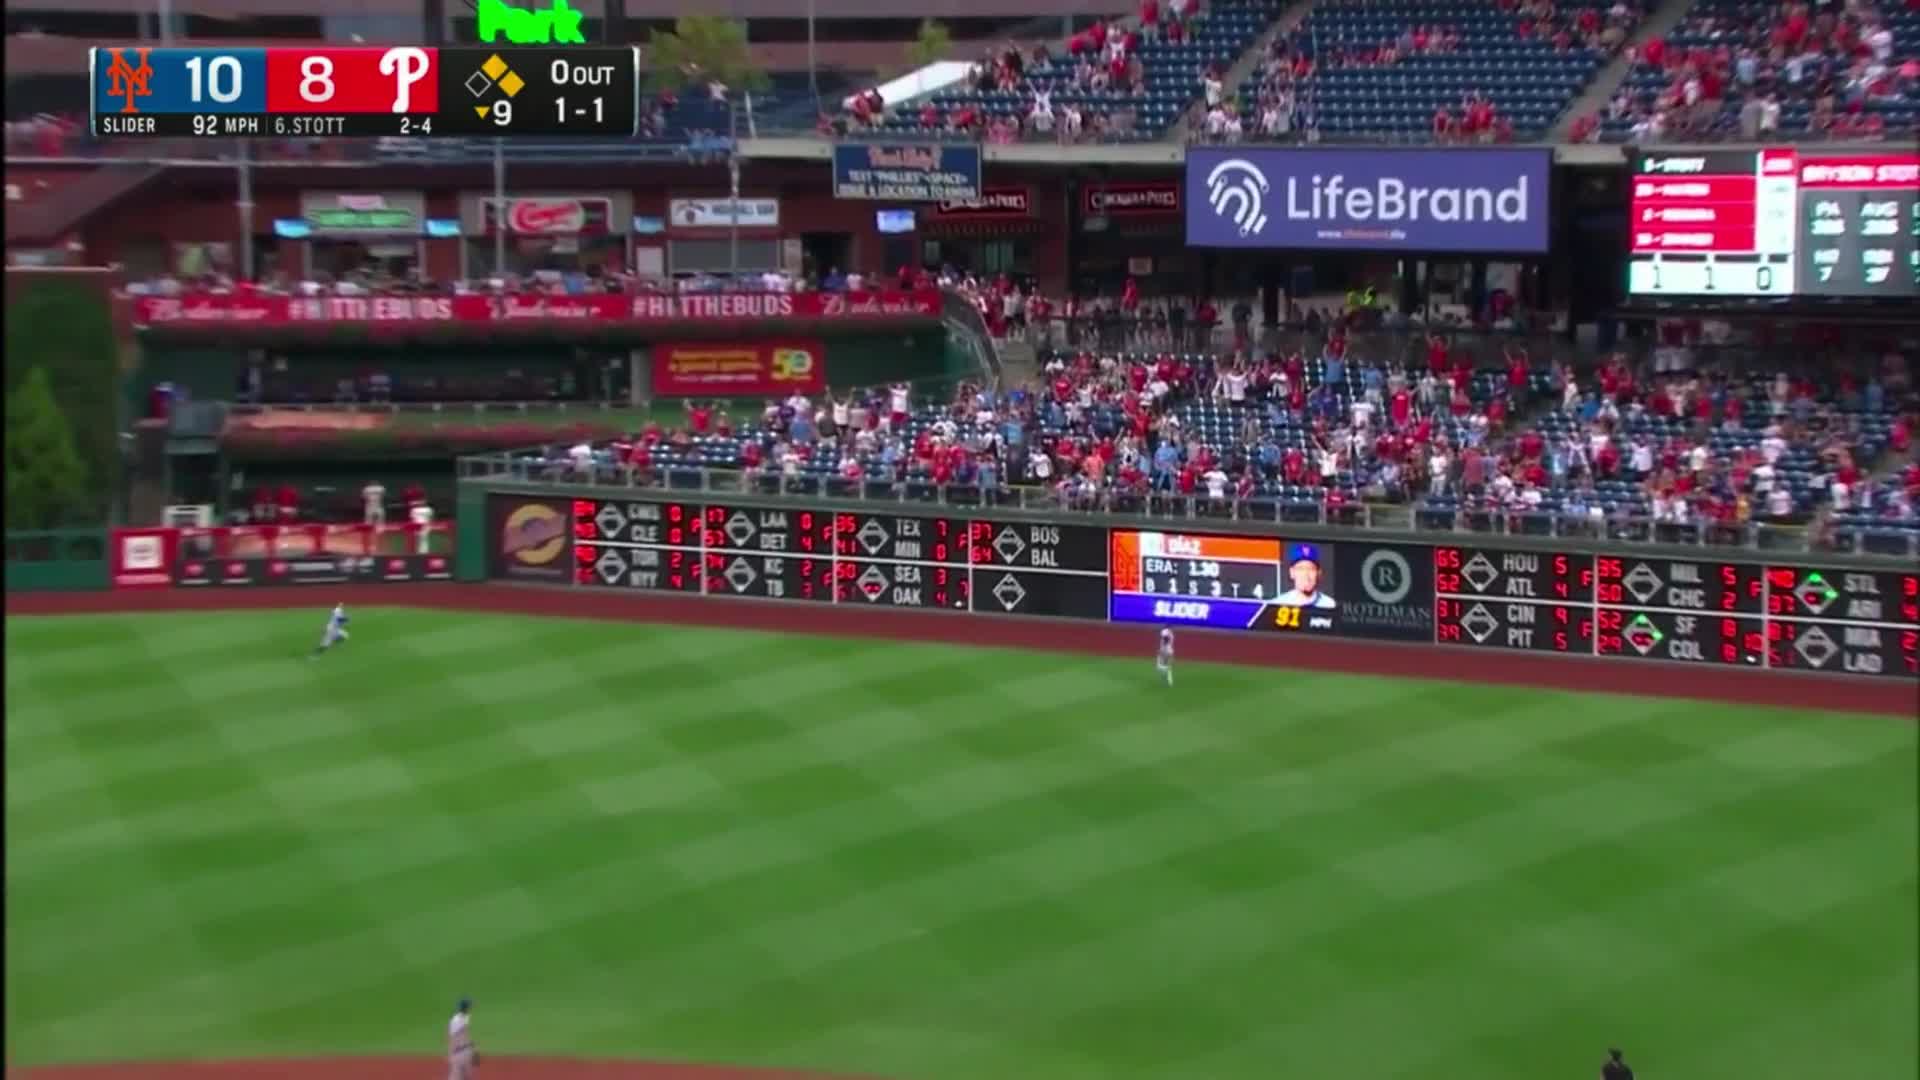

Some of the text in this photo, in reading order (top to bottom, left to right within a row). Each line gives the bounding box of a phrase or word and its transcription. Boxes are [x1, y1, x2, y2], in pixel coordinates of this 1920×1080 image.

[1287, 175, 1528, 221] LifeBrand
[1756, 266, 1773, 290] 0
[760, 511, 788, 528] LAA
[895, 518, 921, 537] TEX
[760, 533, 787, 549] DET
[1030, 526, 1061, 545] BOS
[1030, 548, 1060, 567] BAL
[1145, 558, 1178, 575] ERA:
[1503, 553, 1539, 573] HOU
[895, 565, 921, 583] SEA
[1377, 566, 1396, 586] R
[893, 586, 921, 605] OAK
[1168, 577, 1178, 594] 1
[1188, 580, 1198, 596] S
[1231, 583, 1240, 598] T
[1252, 584, 1264, 600] 4
[1506, 578, 1537, 597] ATL
[1554, 582, 1568, 598] 4
[1667, 587, 1705, 608] CHC
[1153, 600, 1210, 619] SLIDER
[1275, 606, 1301, 628] 91
[1341, 601, 1431, 620] ROTHMAN
[1506, 604, 1536, 623] CIN
[1675, 615, 1698, 635] SF
[1507, 628, 1534, 648] PIT
[1668, 639, 1705, 661] COL
